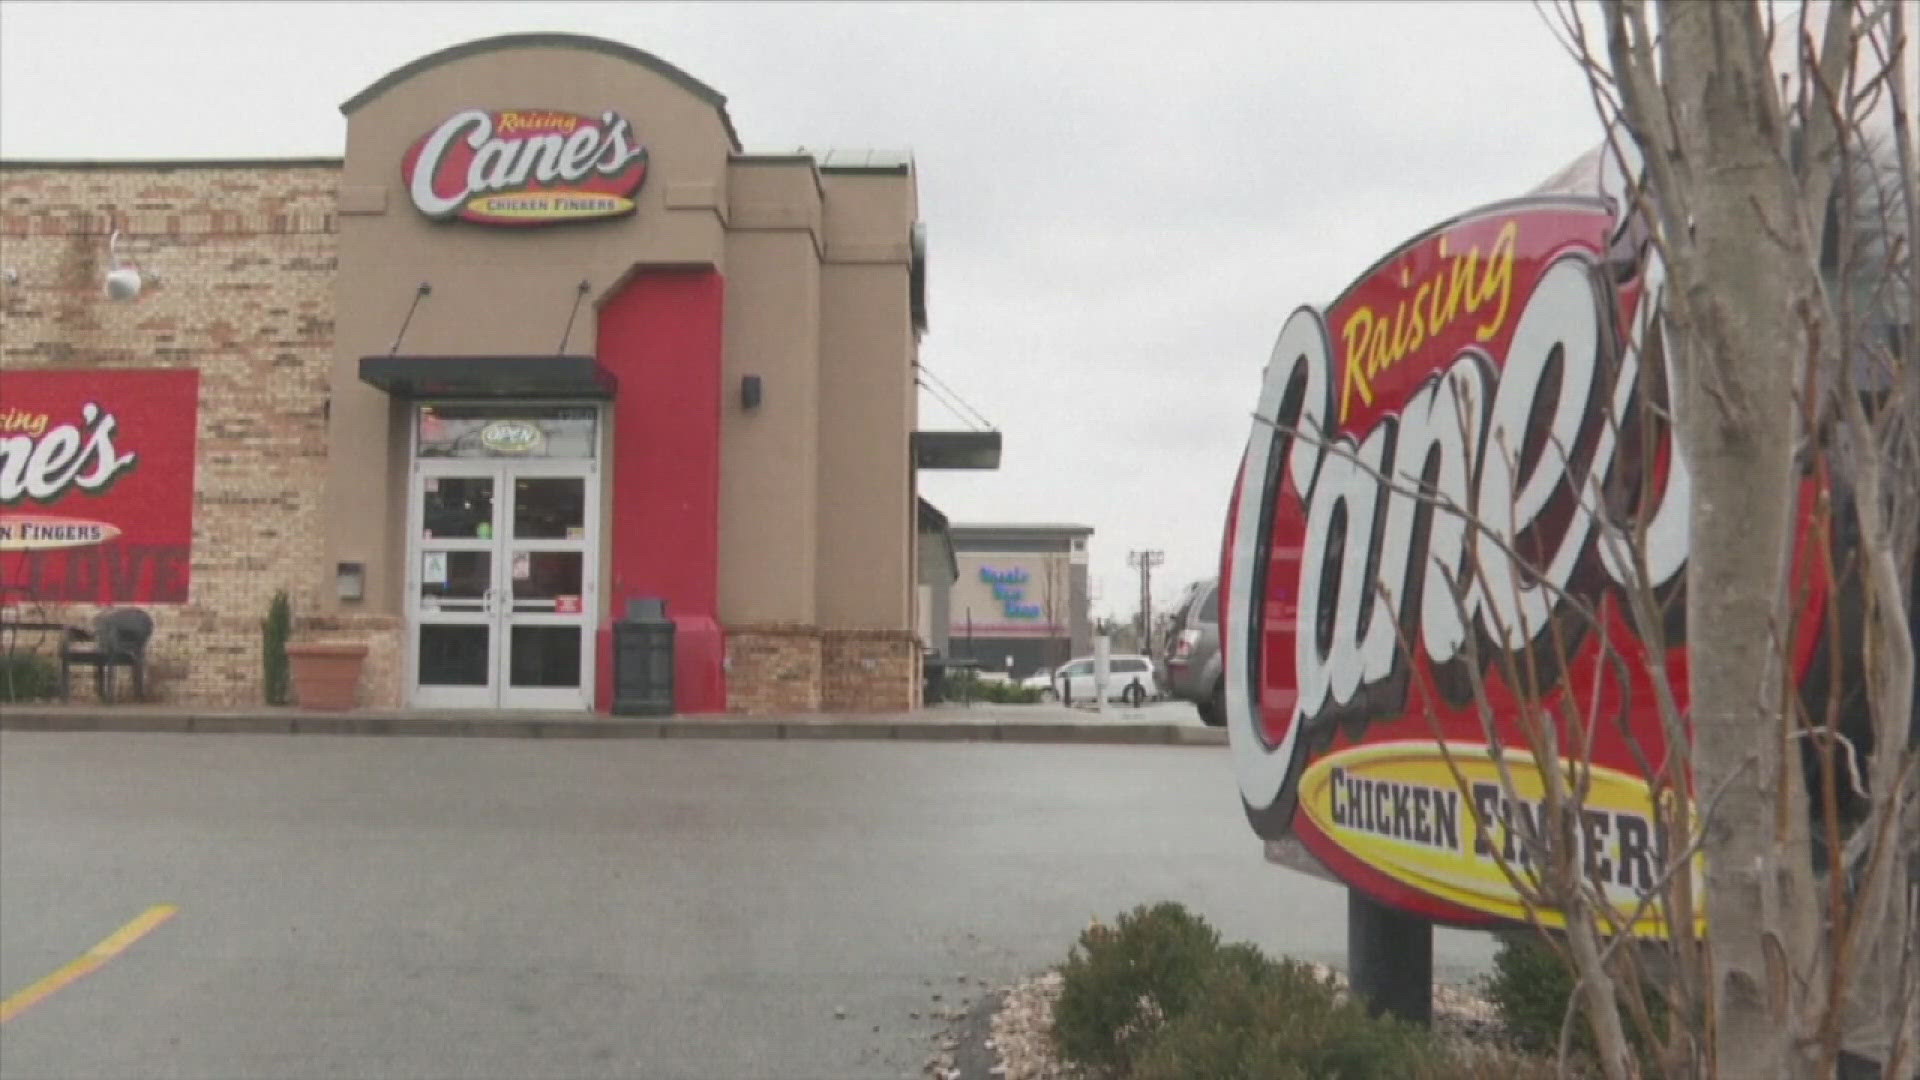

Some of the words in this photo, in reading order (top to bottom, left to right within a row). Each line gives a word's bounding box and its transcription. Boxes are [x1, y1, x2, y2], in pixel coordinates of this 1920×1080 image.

[411, 110, 641, 215] Cane's
[498, 111, 577, 134] Raising
[1339, 222, 1517, 425] Raising
[1330, 766, 1459, 851] CHICKEN
